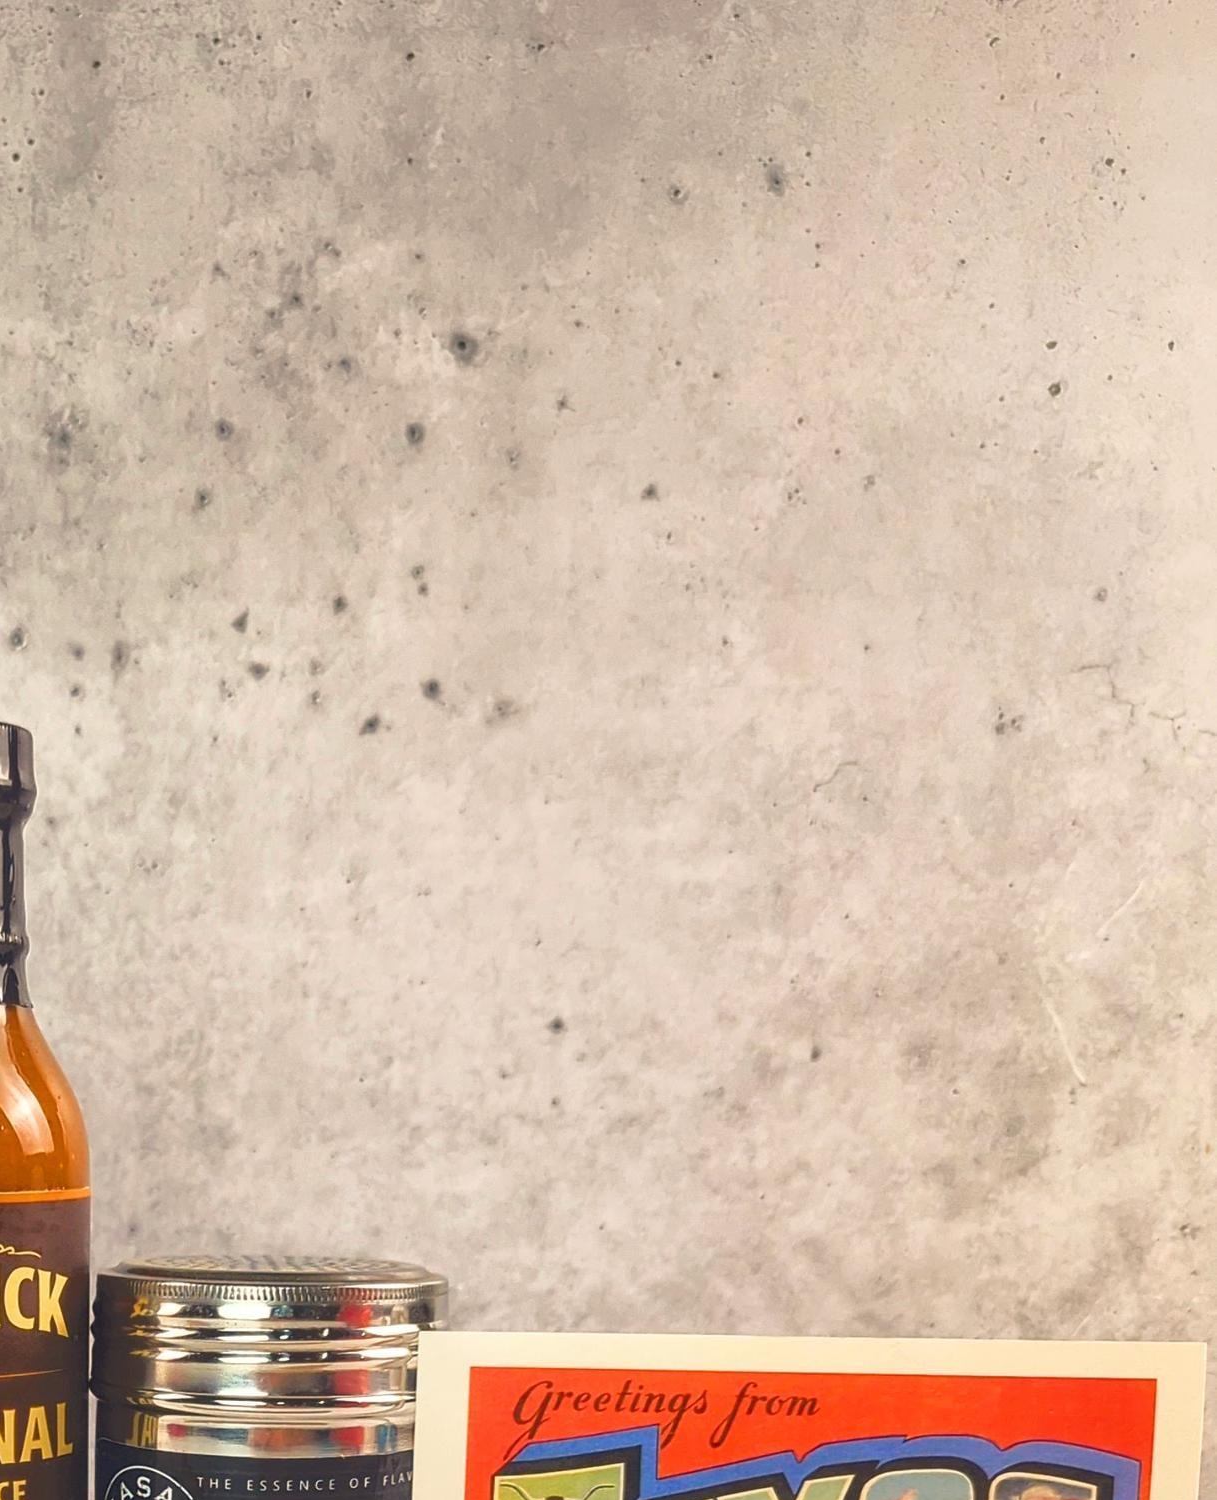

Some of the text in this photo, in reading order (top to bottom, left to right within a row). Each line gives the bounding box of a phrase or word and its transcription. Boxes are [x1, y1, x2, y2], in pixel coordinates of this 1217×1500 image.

[503, 1380, 821, 1462] Greetings from
[197, 1476, 232, 1490] THE
[247, 1479, 336, 1492] ESSENCE
[349, 1476, 372, 1489] OF
